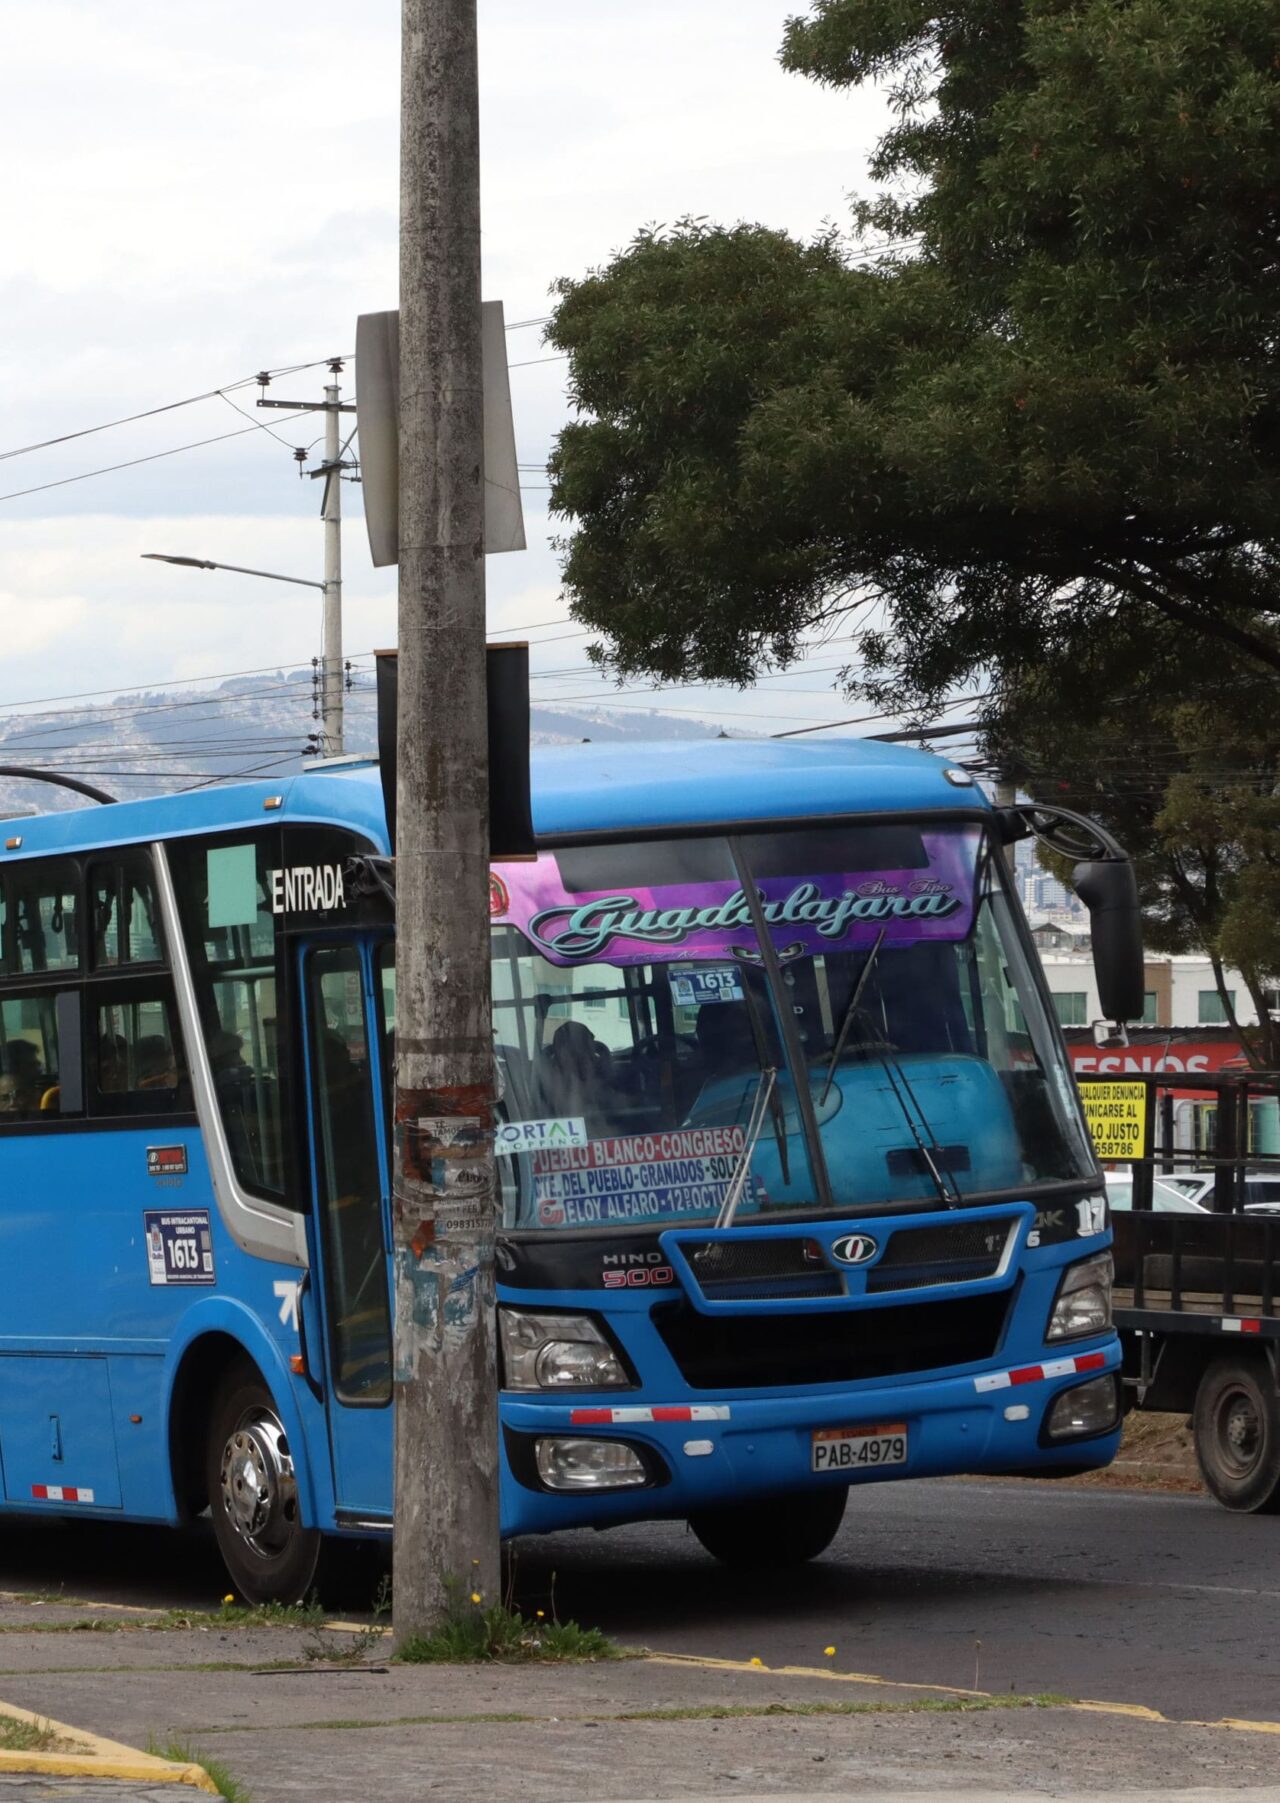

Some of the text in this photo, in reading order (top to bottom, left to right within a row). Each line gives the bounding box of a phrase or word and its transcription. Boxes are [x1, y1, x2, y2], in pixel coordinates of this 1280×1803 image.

[272, 864, 347, 914] ENTRADA
[696, 972, 736, 989] 1613
[1112, 1086, 1144, 1100] DENUNCIA
[1126, 1104, 1137, 1118] AL
[1106, 1123, 1140, 1140] JUSTO
[531, 1143, 590, 1173] PUEBLO
[571, 1199, 602, 1223] ELOY
[607, 1194, 659, 1219] ALFARO
[1075, 1196, 1106, 1237] 17
[167, 1239, 199, 1269] 1613
[603, 1252, 662, 1264] HINO
[602, 1266, 674, 1288] 500
[815, 1438, 904, 1468] PAB-4979
